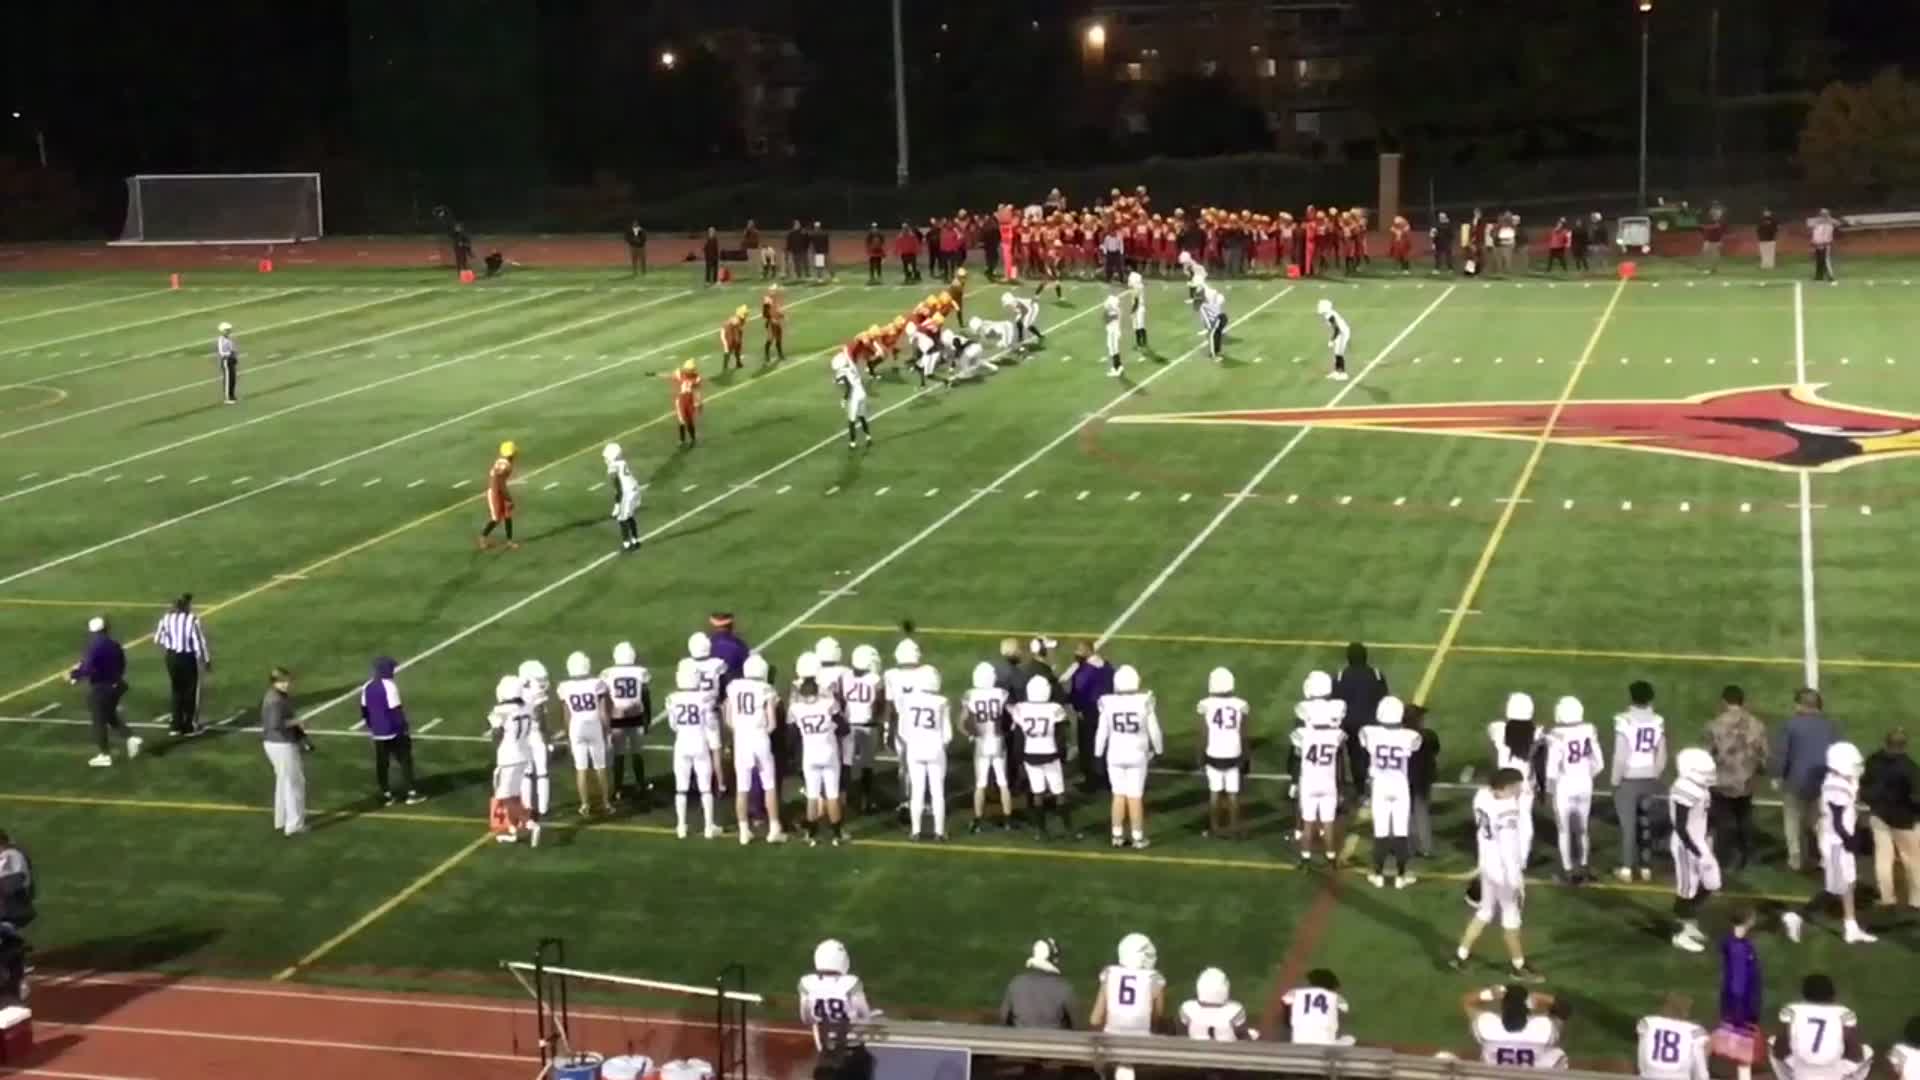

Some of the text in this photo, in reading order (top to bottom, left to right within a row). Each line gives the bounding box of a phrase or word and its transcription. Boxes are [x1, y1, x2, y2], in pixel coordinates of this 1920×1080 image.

[613, 677, 638, 698] 58
[846, 682, 871, 703] 20
[569, 692, 597, 713] 88
[675, 704, 701, 725] 28
[737, 691, 756, 716] 10
[974, 698, 1000, 723] 80
[800, 713, 827, 734] 62
[909, 706, 936, 730] 73
[1023, 716, 1050, 738] 27
[1112, 711, 1140, 734] 65
[1212, 705, 1237, 729] 43
[1567, 736, 1593, 764] 84
[1634, 726, 1655, 753] 19
[1305, 743, 1334, 766] 45
[1375, 744, 1404, 769] 55
[1118, 974, 1138, 1006] 6
[813, 997, 848, 1023] 48
[1303, 992, 1330, 1015] 14
[1651, 1028, 1681, 1064] 18
[1807, 1017, 1827, 1054] 7
